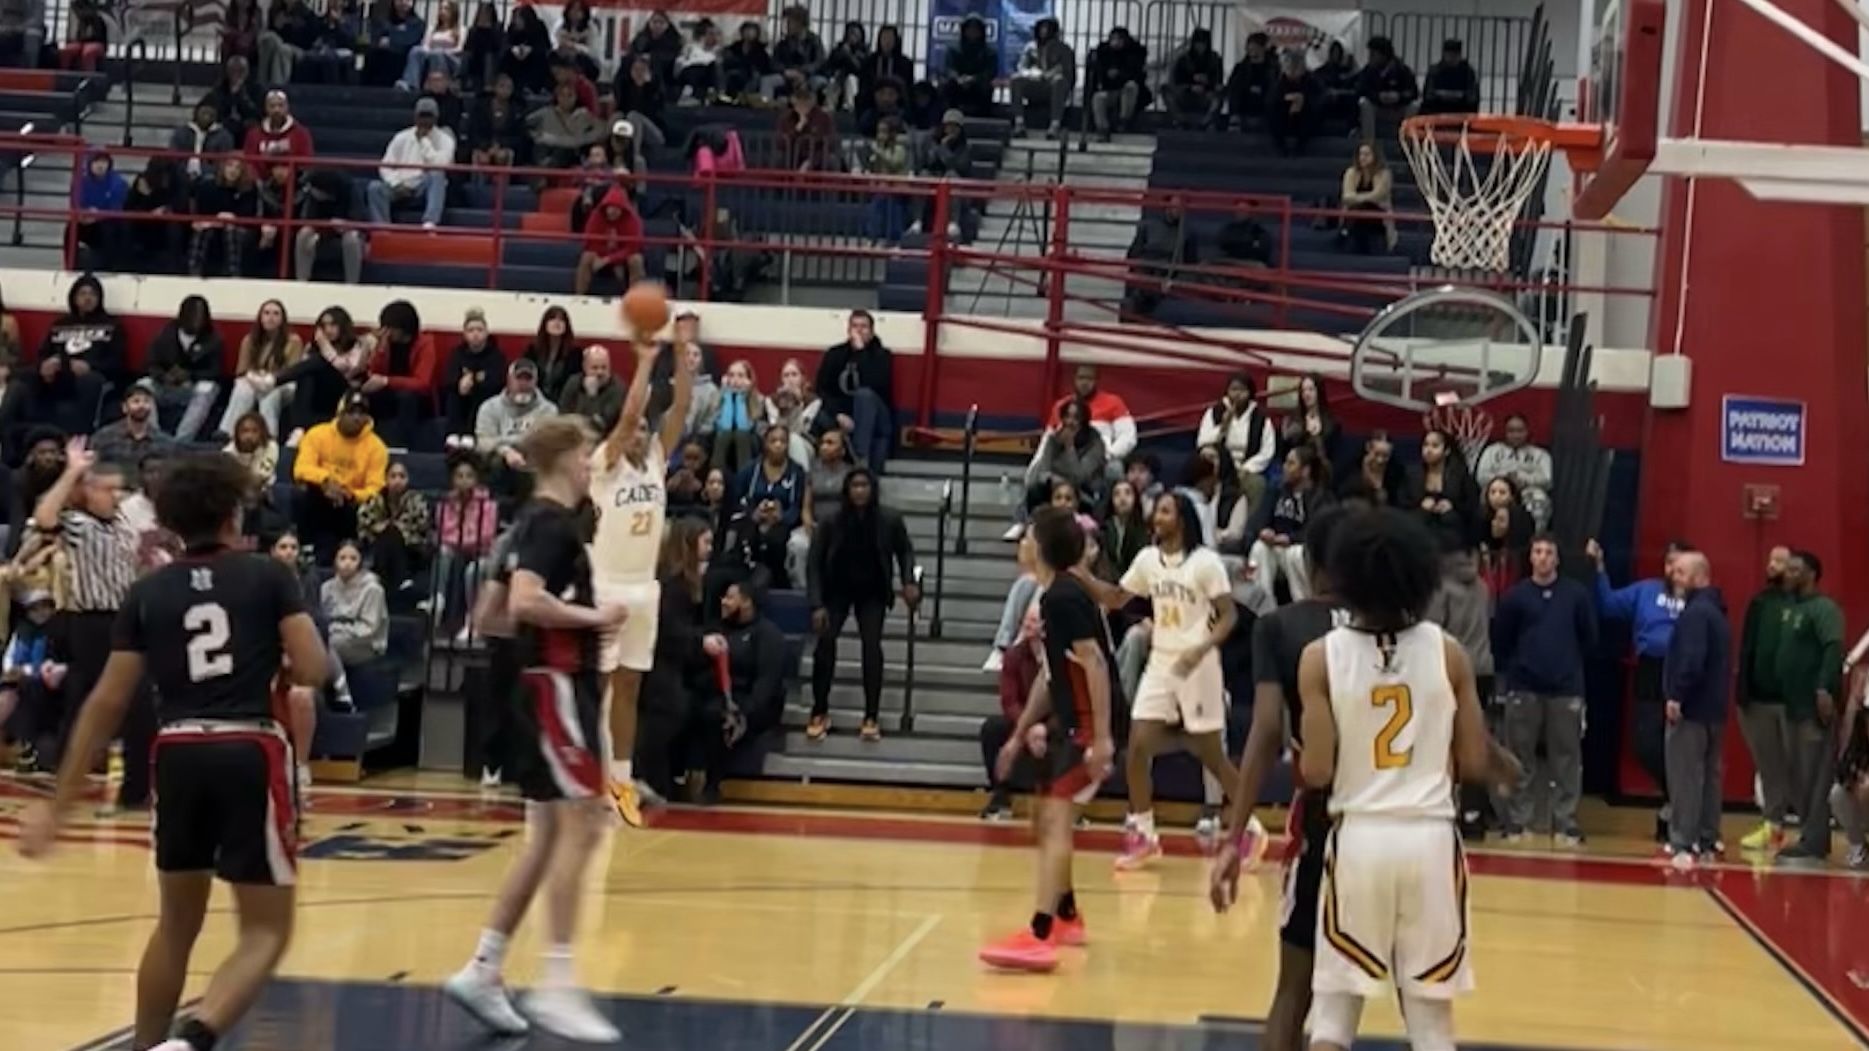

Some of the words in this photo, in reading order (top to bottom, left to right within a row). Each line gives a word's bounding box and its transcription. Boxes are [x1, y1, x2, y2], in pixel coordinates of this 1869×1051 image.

[1729, 411, 1799, 431] PATRIOT
[1732, 432, 1796, 452] NATION
[1160, 605, 1180, 627] 24
[184, 603, 233, 683] 2
[1371, 684, 1414, 770] 2
